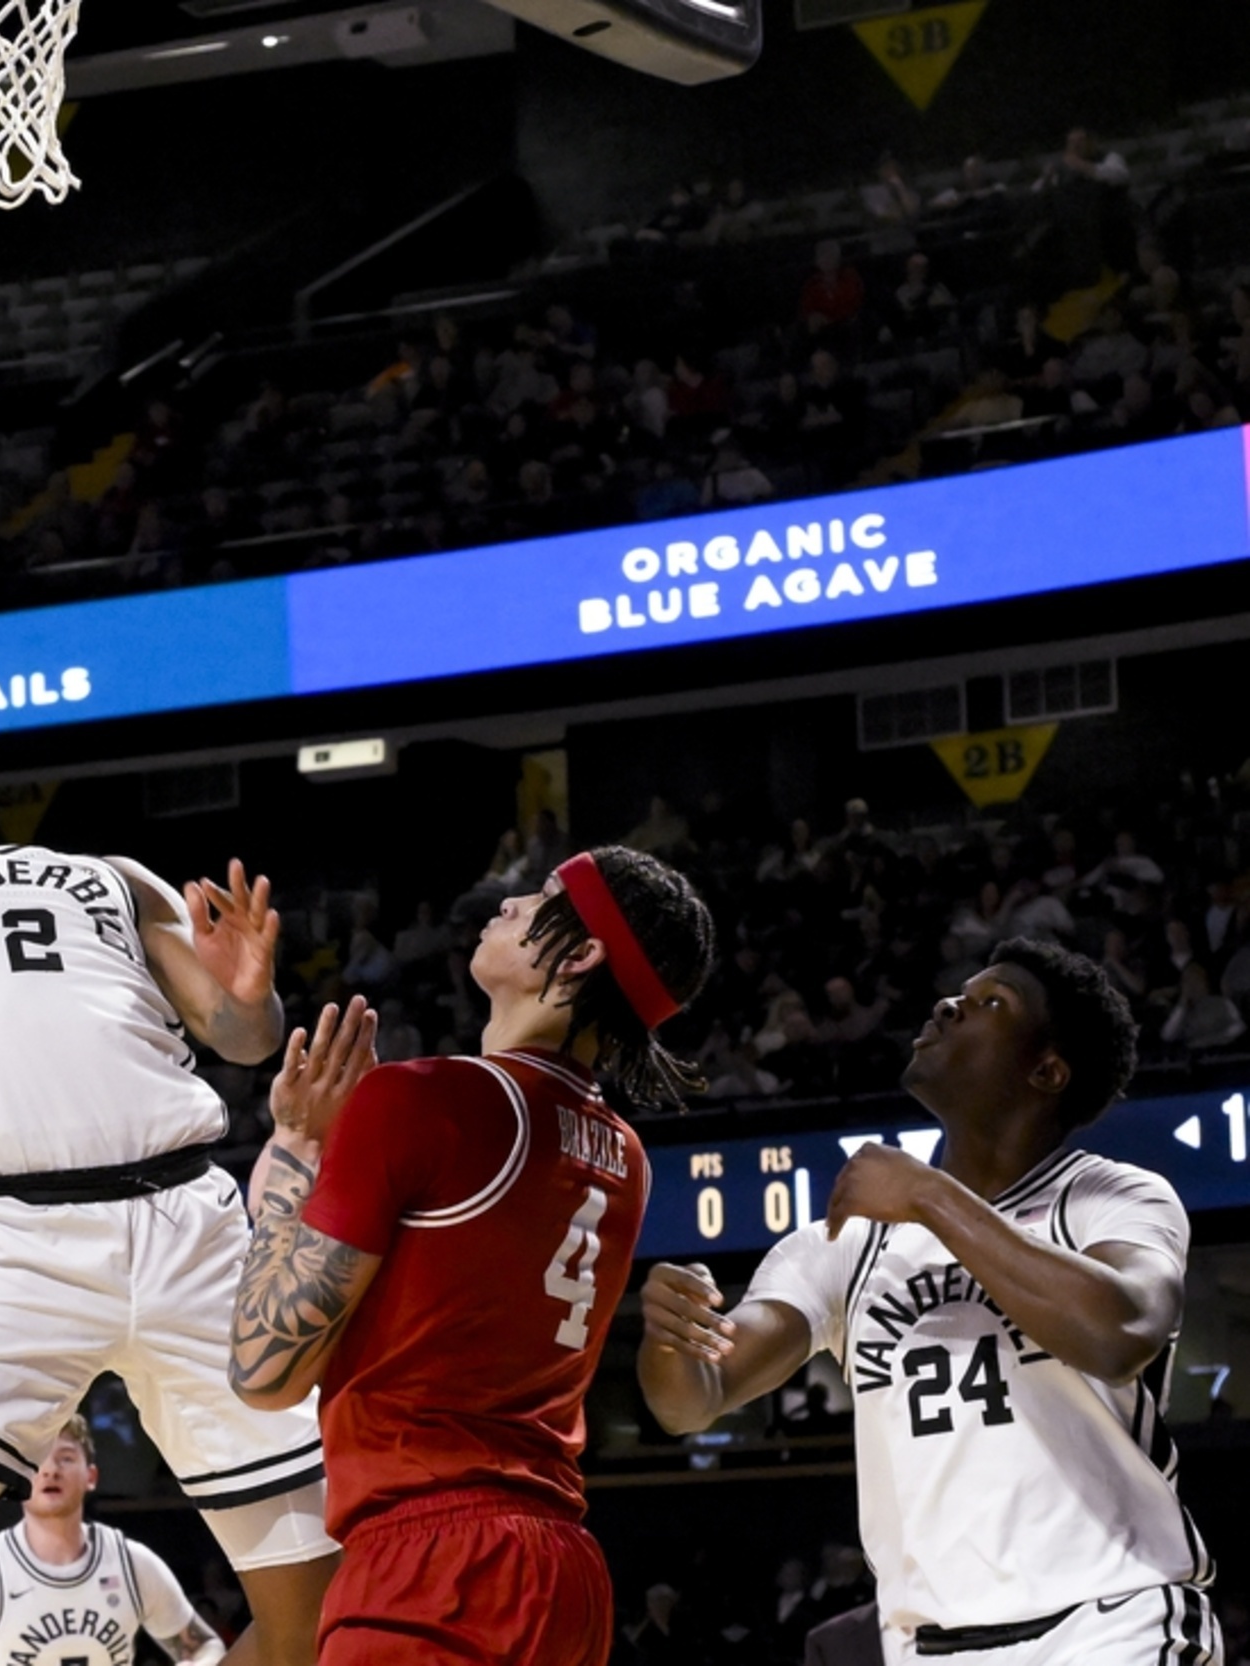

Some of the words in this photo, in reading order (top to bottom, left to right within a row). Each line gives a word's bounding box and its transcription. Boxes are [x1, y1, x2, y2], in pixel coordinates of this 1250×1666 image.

[622, 513, 886, 582] ORGANIC
[579, 582, 720, 634] BLUE
[744, 550, 938, 611] AGAVE
[963, 739, 1026, 779] 2B
[2, 908, 64, 972] 2
[1221, 1092, 1250, 1162] 1
[690, 1152, 723, 1179] PTS
[760, 1146, 792, 1173] FLS
[697, 1187, 723, 1239] 0
[764, 1181, 790, 1232] 0
[543, 1185, 607, 1350] 4
[902, 1333, 1014, 1437] 24
